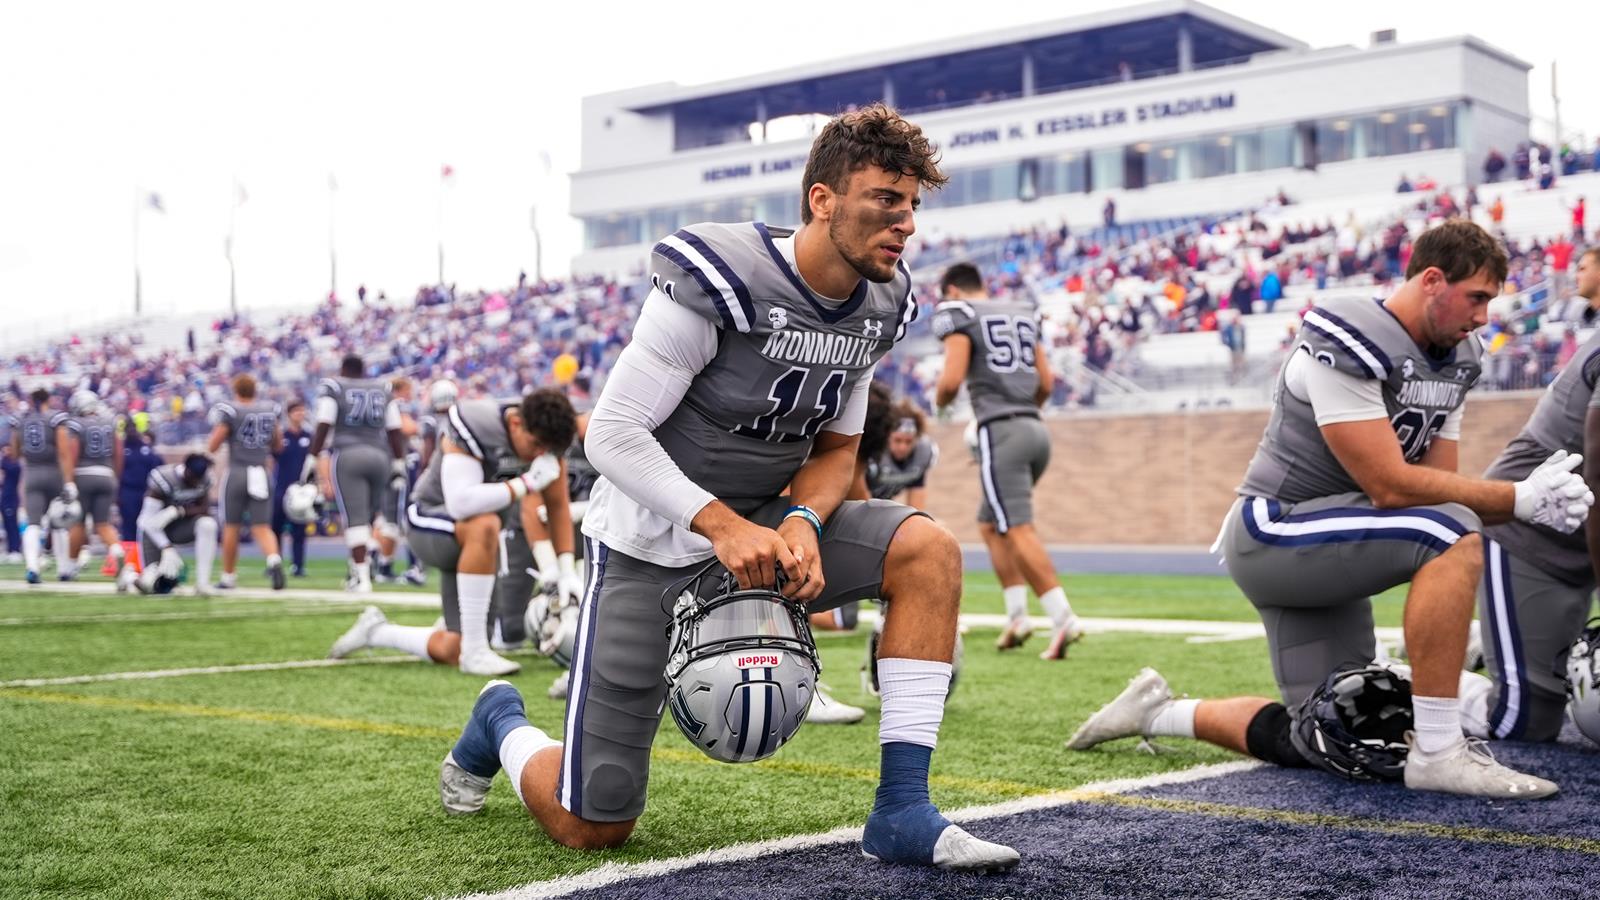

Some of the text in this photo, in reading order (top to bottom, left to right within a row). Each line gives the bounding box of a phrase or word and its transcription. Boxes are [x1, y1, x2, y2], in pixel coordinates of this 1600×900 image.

[1137, 92, 1235, 121] STADIUM
[761, 330, 880, 366] MONMOUTH
[981, 314, 1037, 373] 56
[345, 388, 387, 428] 76
[728, 366, 848, 443] 11
[1397, 380, 1464, 407] MONMOUTH
[236, 412, 277, 450] 45
[737, 655, 779, 668] Riddell
